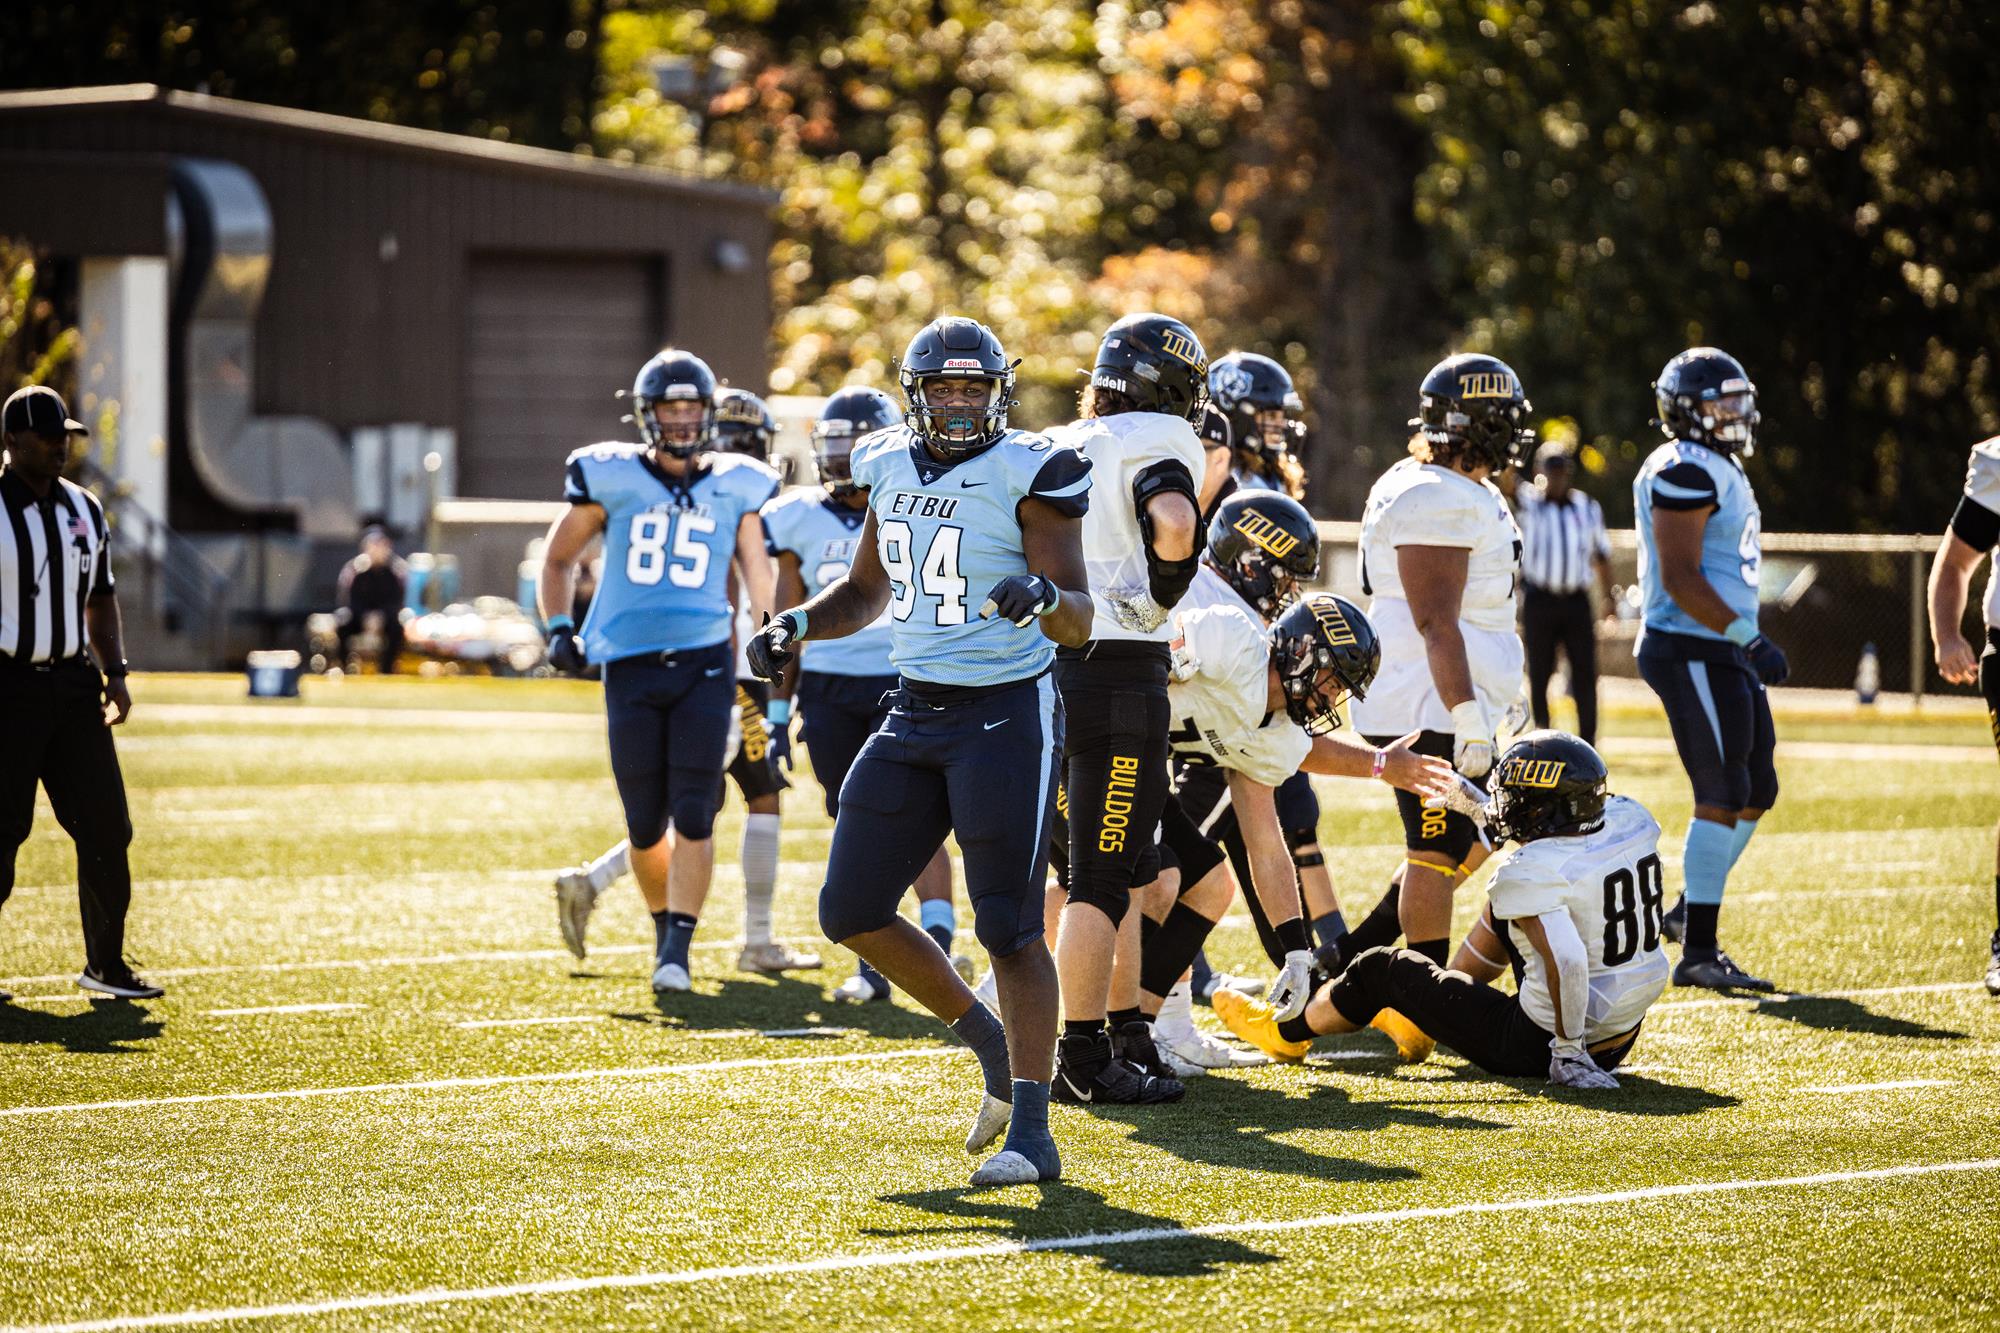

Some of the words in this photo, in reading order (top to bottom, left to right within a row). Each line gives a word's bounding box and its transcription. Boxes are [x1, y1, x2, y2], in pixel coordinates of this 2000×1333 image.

[1459, 373, 1513, 399] TLU
[891, 492, 960, 520] ETBU
[1233, 508, 1300, 558] TLU
[625, 512, 717, 590] 85
[878, 519, 968, 627] 94
[1738, 510, 1761, 588] 9
[1308, 598, 1357, 646] TLU
[1098, 755, 1138, 852] BULLDOGS
[1503, 757, 1567, 788] TLU
[1602, 852, 1663, 967] 88
